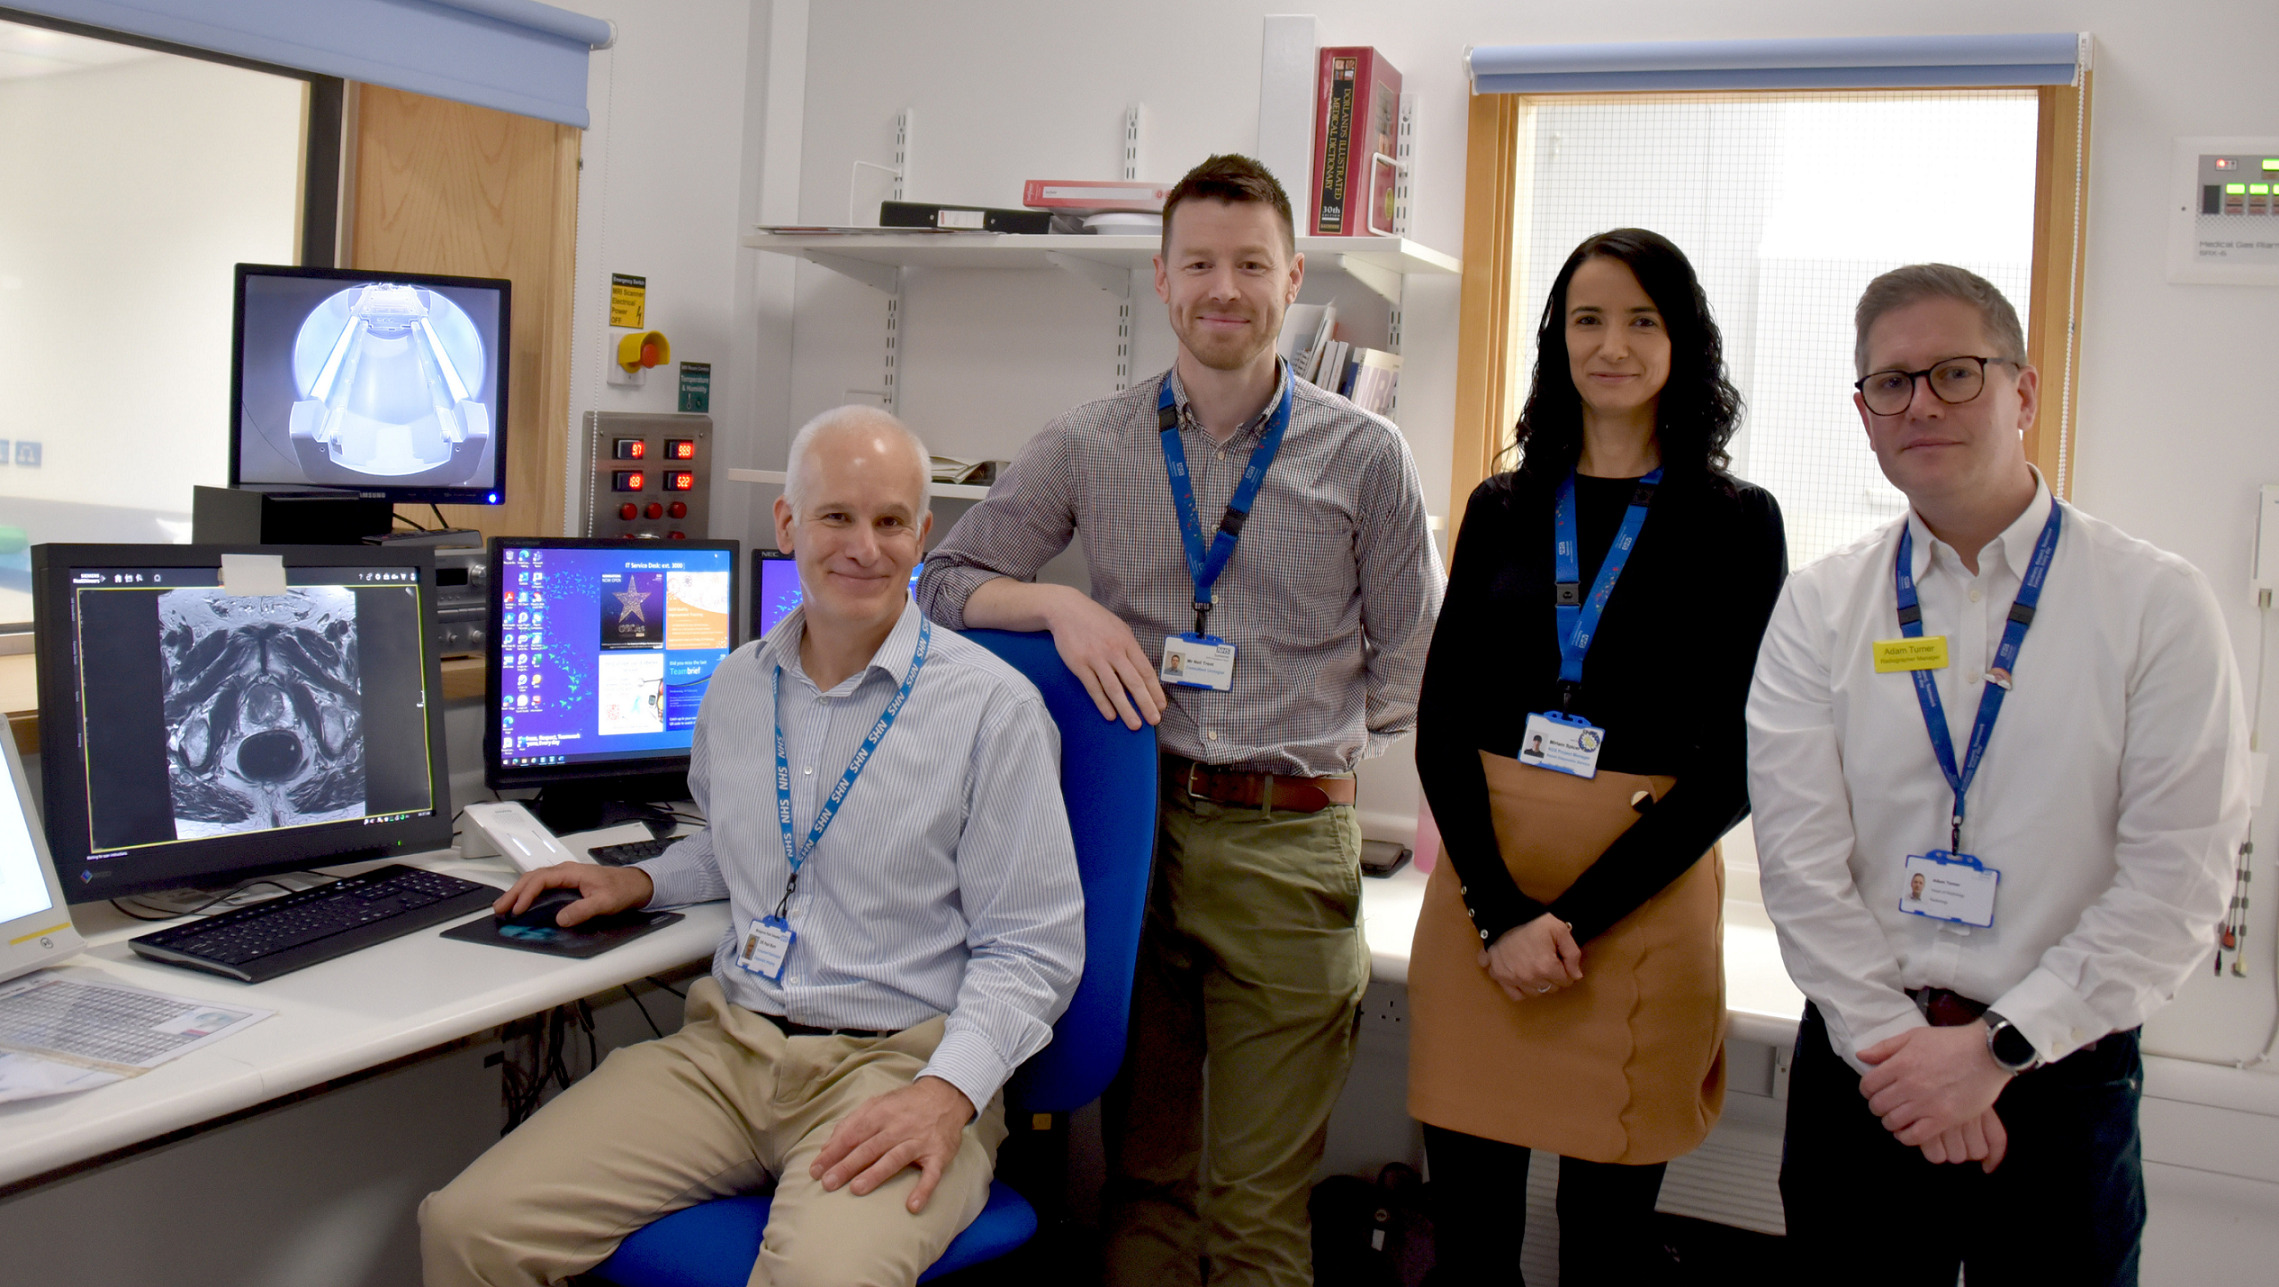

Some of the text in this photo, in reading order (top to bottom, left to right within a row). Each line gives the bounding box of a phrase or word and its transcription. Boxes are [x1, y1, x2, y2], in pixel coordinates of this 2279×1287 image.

[1325, 97, 1341, 190] MEDICAL DICTIONARY
[1334, 139, 1346, 200] ILLUSTRATED
[623, 289, 644, 297] Scanner
[612, 306, 627, 315] Power
[917, 636, 927, 659] NHS
[1885, 646, 1934, 655] Adam Turner
[670, 667, 701, 675] Teambrief
[906, 664, 918, 687] NHS
[888, 692, 905, 716] NHS
[868, 719, 887, 744] NHS
[850, 748, 868, 773] NHS
[778, 766, 788, 790] NHS
[831, 778, 850, 803] NHS
[780, 799, 790, 823] NHS
[814, 808, 832, 833] NHS
[783, 832, 793, 857] NHS
